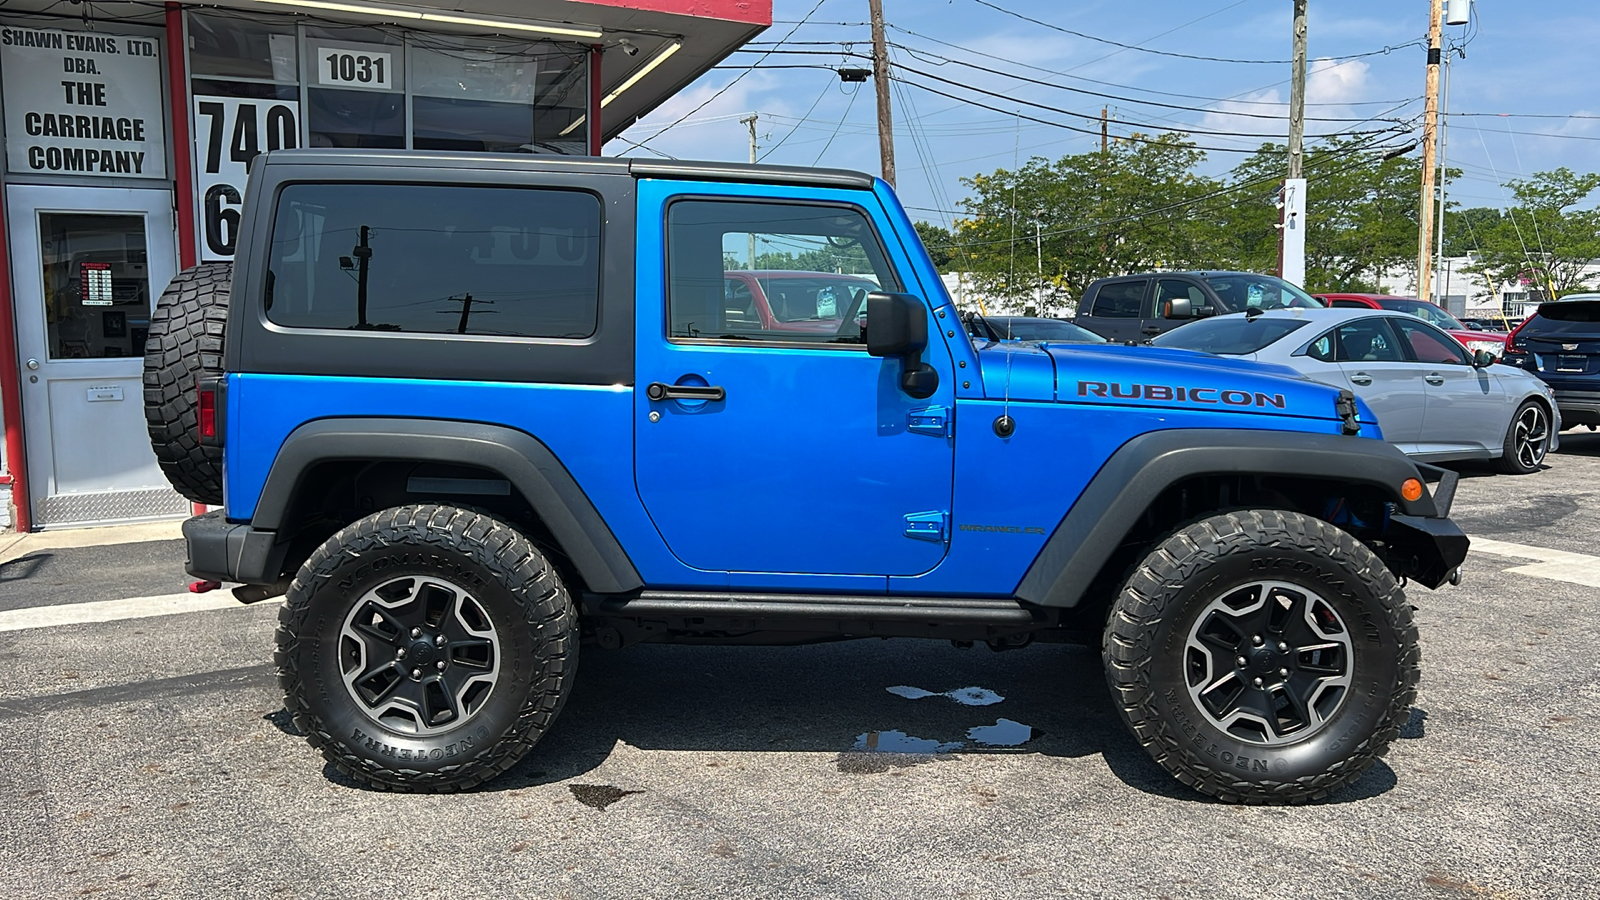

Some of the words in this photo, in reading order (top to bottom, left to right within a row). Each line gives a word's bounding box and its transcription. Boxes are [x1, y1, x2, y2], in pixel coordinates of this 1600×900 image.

[2, 29, 63, 50] SHAWN
[66, 34, 121, 54] EVANS.
[127, 40, 157, 57] LTD.
[63, 57, 101, 75] DBA.
[326, 53, 384, 84] 1031
[61, 80, 107, 107] THE
[25, 112, 146, 142] CARRIAGE
[198, 101, 297, 175] 740
[28, 146, 145, 174] COMPANY
[1077, 381, 1287, 409] RUBICON
[959, 524, 1046, 535] WRANGLER
[1164, 688, 1269, 773] NEOTERRA
[350, 728, 475, 762] NEOTERRA
